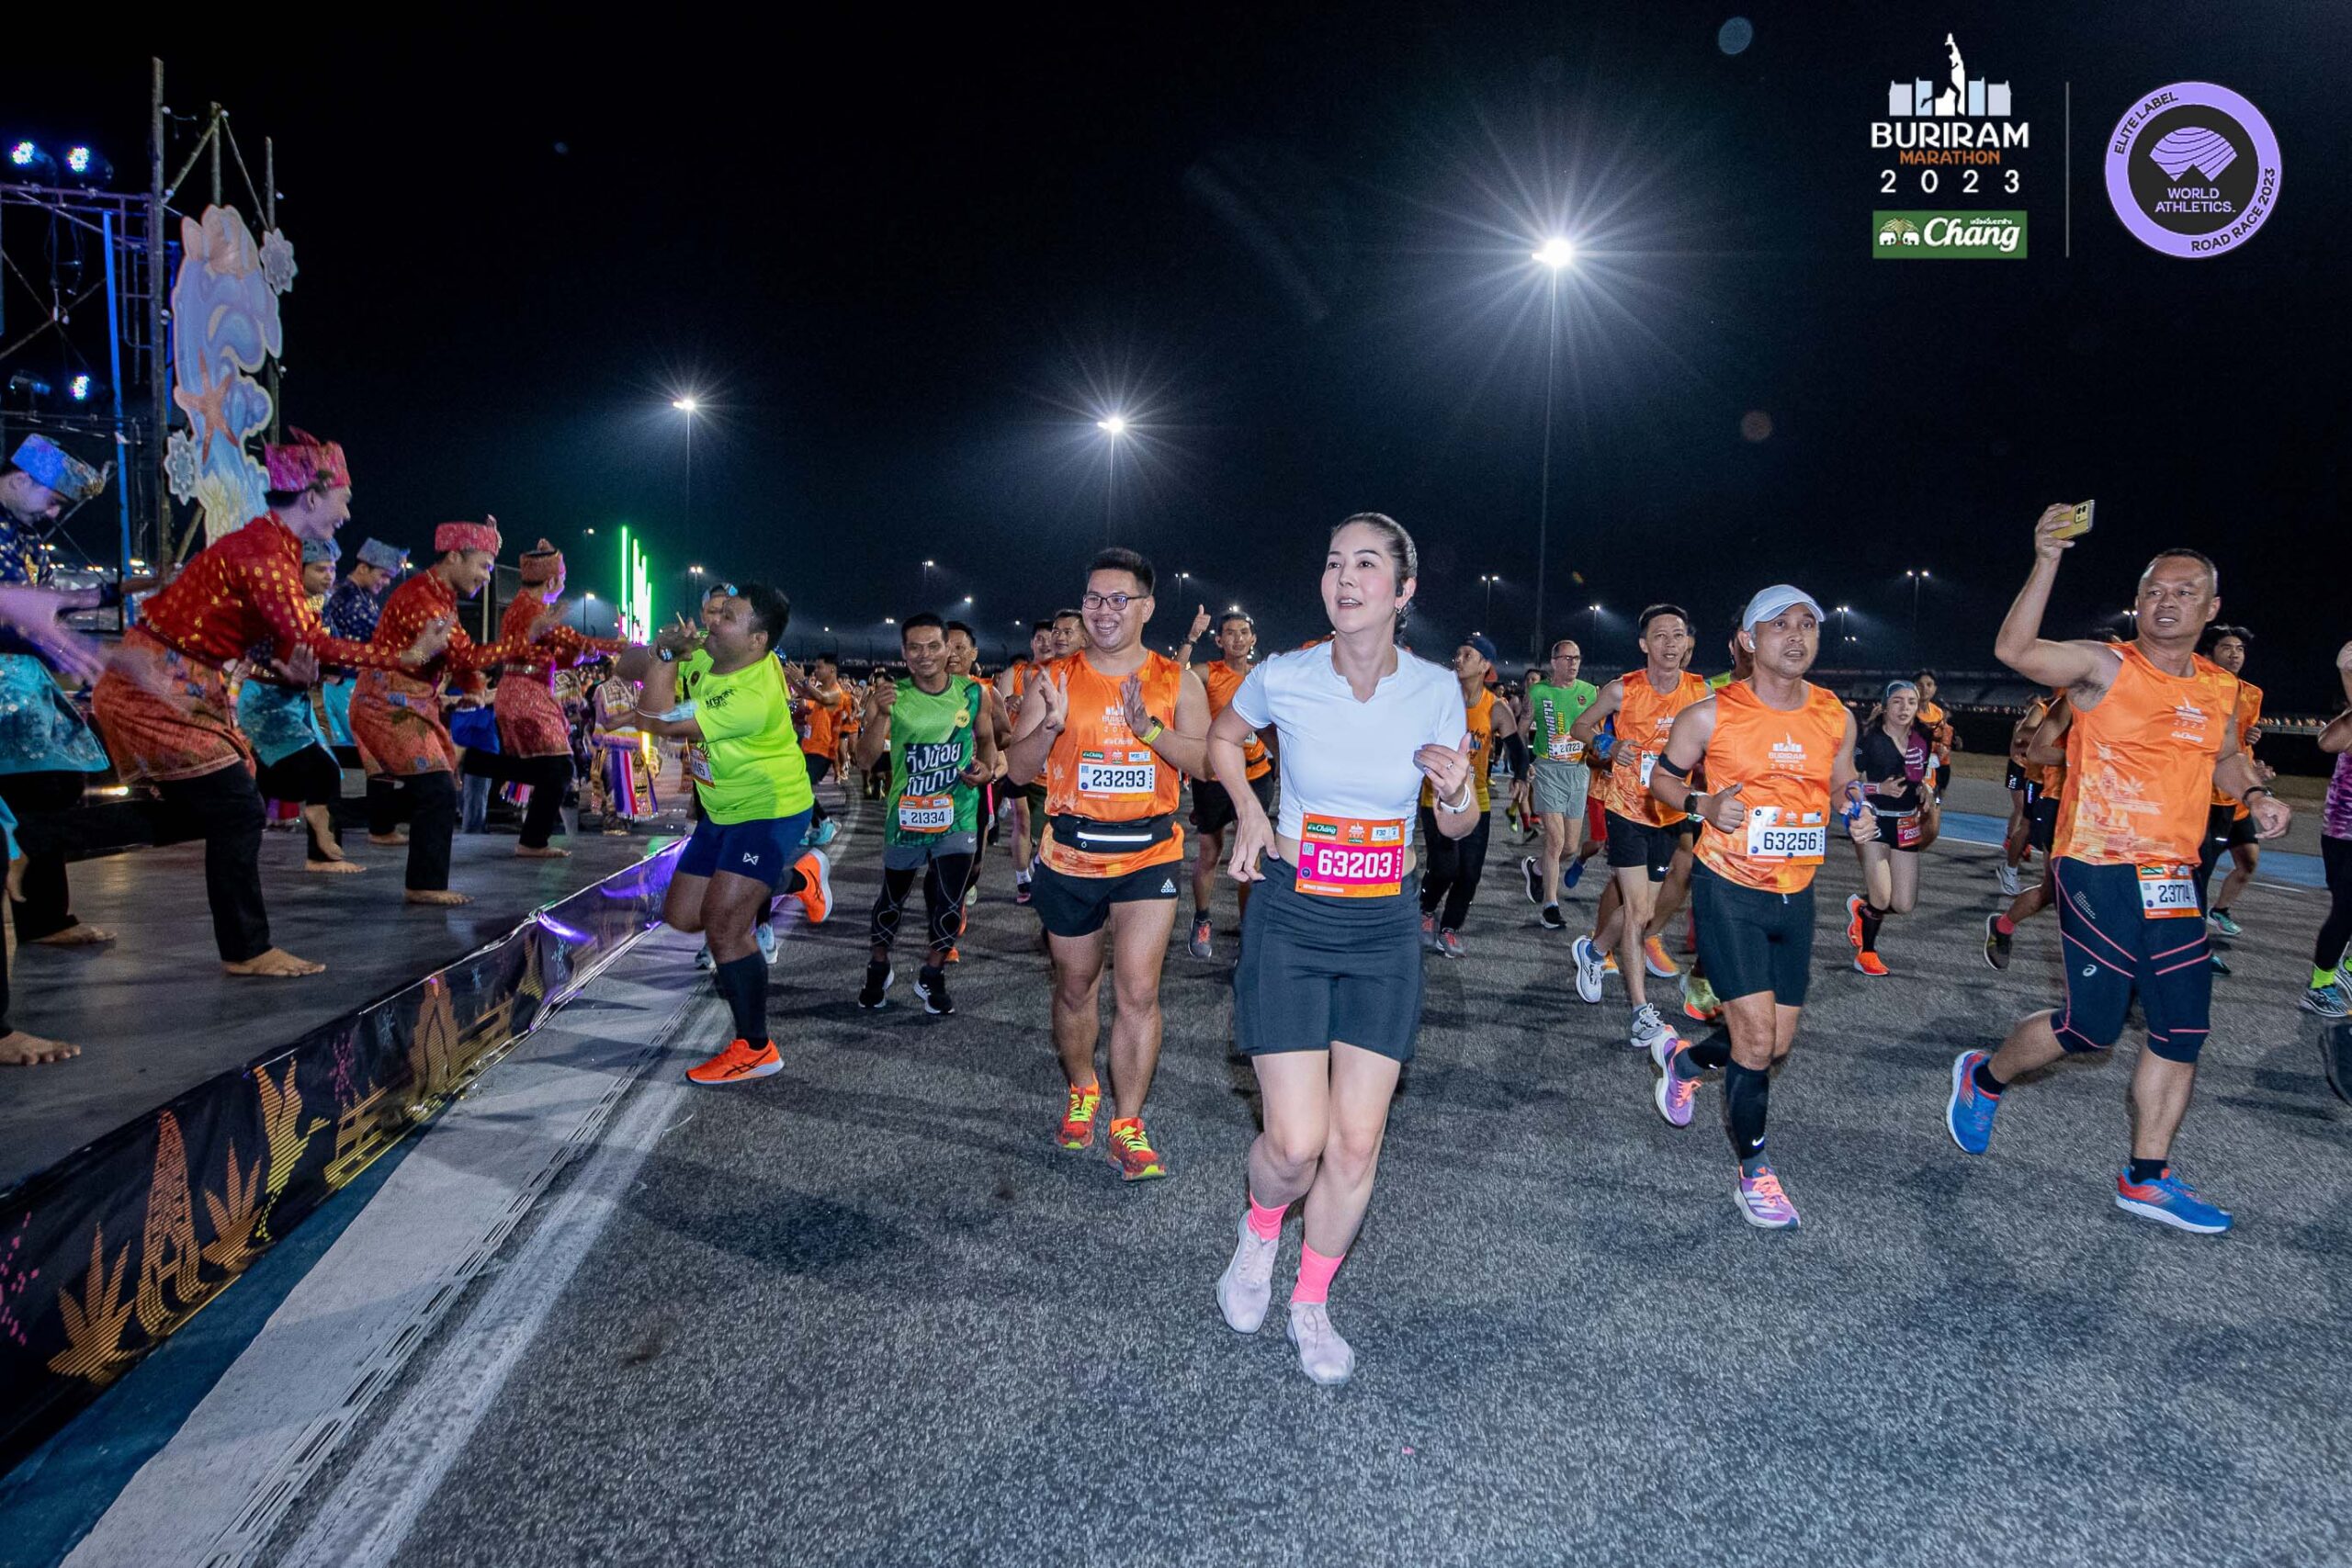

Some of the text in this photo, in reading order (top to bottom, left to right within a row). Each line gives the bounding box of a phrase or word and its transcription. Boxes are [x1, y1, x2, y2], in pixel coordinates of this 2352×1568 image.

[1092, 769, 1146, 787] 23293
[910, 811, 945, 824] 21334
[1764, 831, 1817, 851] 63256
[1317, 849, 1393, 878] 63203
